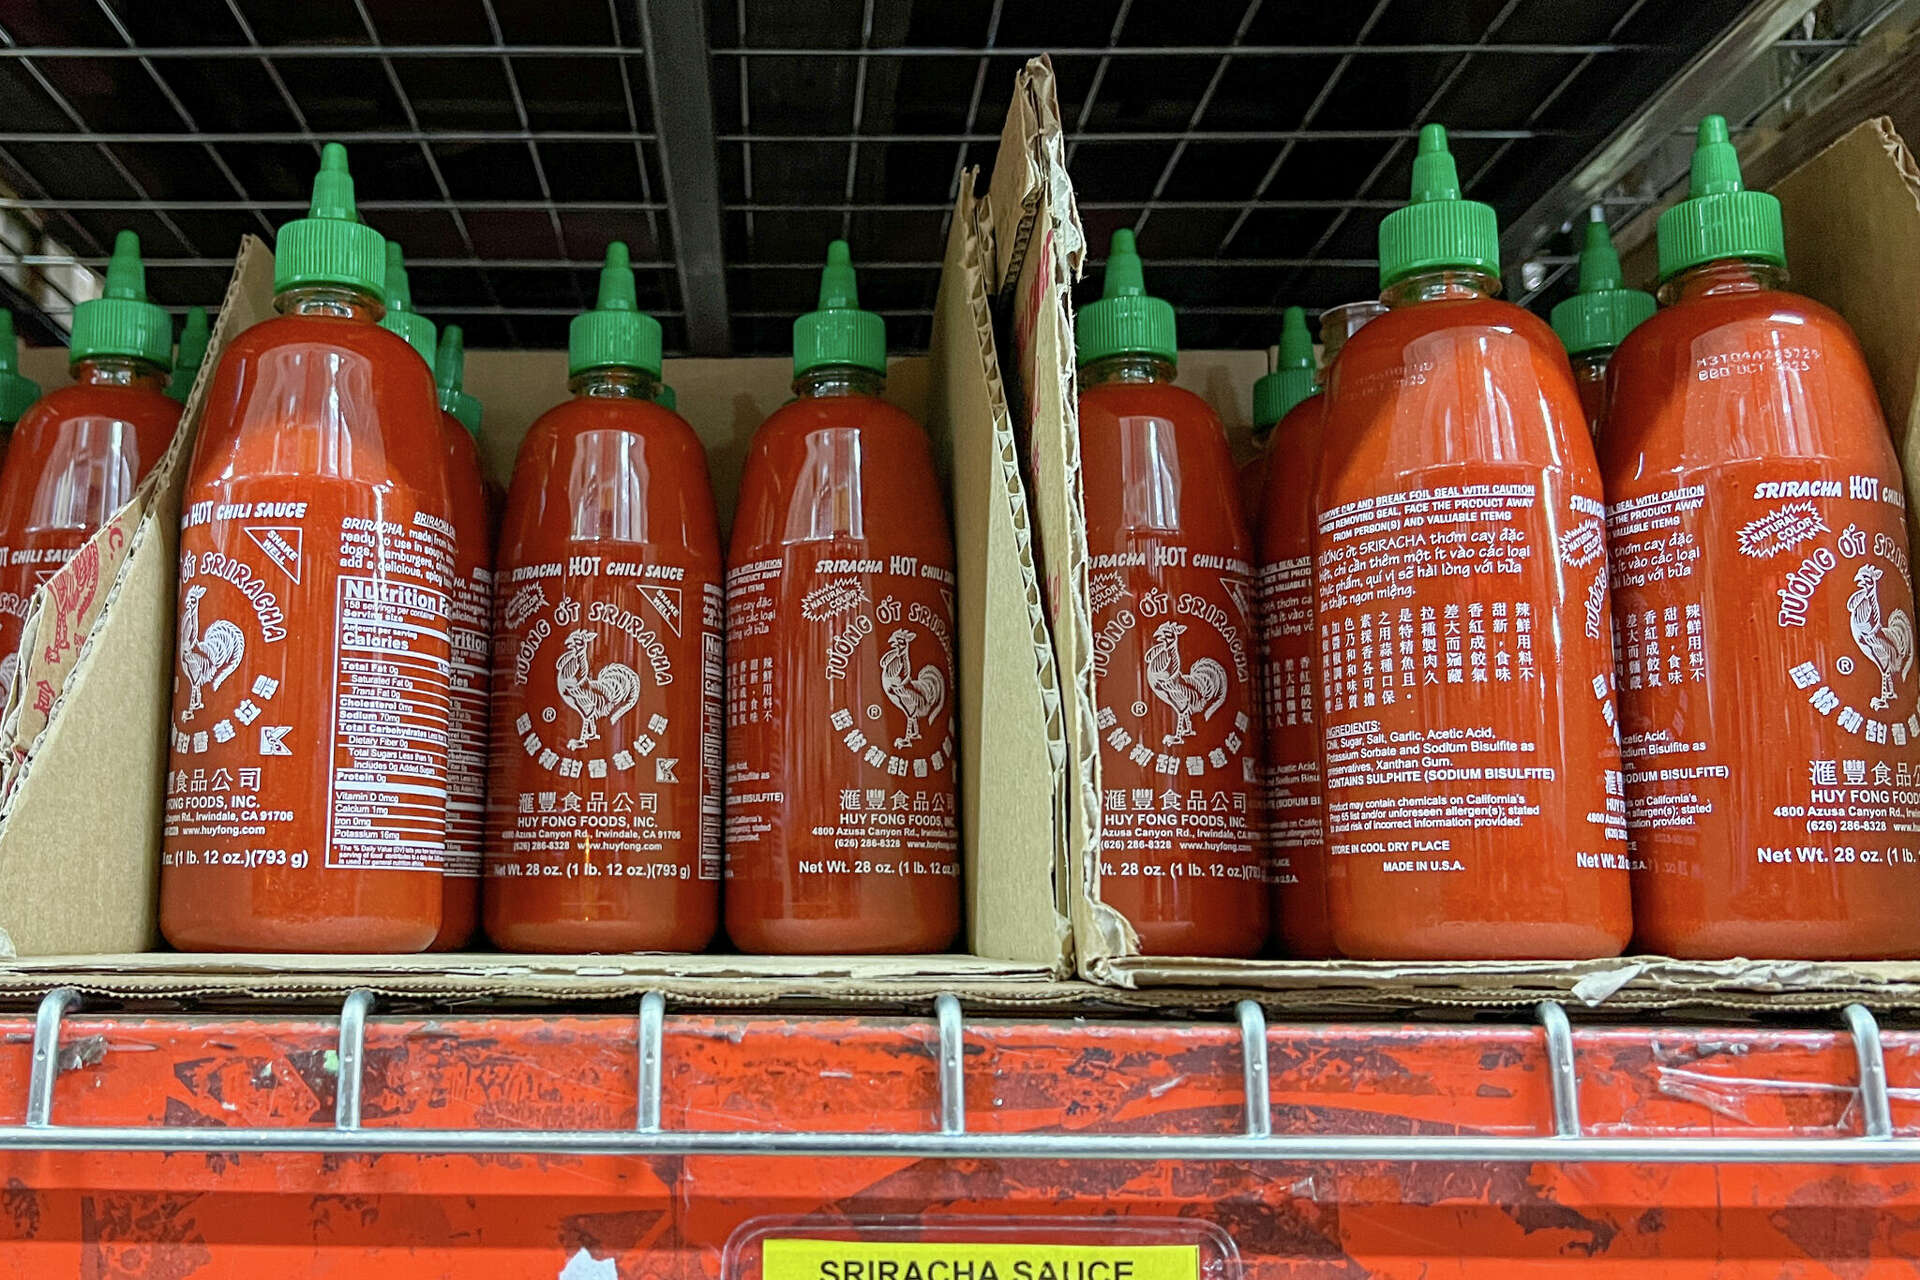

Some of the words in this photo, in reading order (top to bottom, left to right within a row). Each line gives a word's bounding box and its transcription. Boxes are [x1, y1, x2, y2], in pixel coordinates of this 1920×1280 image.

[1462, 486, 1489, 495] WITH
[1493, 485, 1535, 495] CAUTION
[1662, 485, 1705, 501] CAUTION
[1754, 480, 1842, 500] SRIRACHA
[1850, 476, 1878, 502] HOT
[1405, 503, 1429, 514] FACE
[1432, 501, 1453, 511] THE
[1455, 499, 1503, 509] PRODUCT
[1506, 498, 1533, 507] AWAY
[1630, 504, 1671, 520] PRODUCT
[1675, 499, 1704, 511] AWAY
[191, 501, 213, 527] HOT
[217, 504, 252, 520] CHILI
[254, 503, 307, 518] SAUCE
[1404, 516, 1424, 528] AND
[1427, 513, 1477, 524] VALUABLE
[1480, 511, 1512, 521] ITEMS
[1750, 514, 1799, 543] NATURAL
[1777, 517, 1813, 541] COLOR
[267, 529, 298, 561] SHAKE
[341, 532, 375, 547] ready
[394, 539, 411, 549] use
[1360, 534, 1426, 555] SRIRACHA
[1471, 532, 1495, 544] cay
[12, 550, 42, 564] CHILI
[263, 539, 286, 566] WELL
[1154, 547, 1187, 567] HOT
[1193, 555, 1224, 569] CHILI
[340, 558, 362, 568] add
[569, 557, 601, 577] HOT
[606, 562, 642, 577] CHILI
[646, 565, 684, 581] SAUCE
[815, 560, 883, 574] SRIRACHA
[890, 555, 917, 577] HOT
[1442, 562, 1470, 577] lòng
[200, 551, 287, 643] SRIRACHA
[346, 580, 435, 611] Nutrition
[653, 598, 670, 621] WELL
[655, 589, 680, 617] SHAKE
[343, 632, 409, 650] Calories
[588, 602, 672, 686] SRIRACHA
[341, 661, 368, 671] Total
[340, 698, 397, 711] Cholesterol
[340, 711, 378, 721] Sodium
[1390, 731, 1424, 742] Garlic,
[1427, 728, 1463, 739] Acetic
[1361, 748, 1396, 758] Sorbate
[1400, 744, 1419, 755] and
[1423, 743, 1467, 753] Sodium
[1471, 741, 1517, 752] Bisulfite
[1520, 742, 1534, 751] as
[1376, 760, 1418, 770] Xanthan
[1422, 757, 1453, 766] Gum.
[336, 772, 374, 782] Protein
[1367, 771, 1421, 784] SULPHITE
[1424, 769, 1481, 783] (SODIUM
[1485, 768, 1555, 781] BISULFITE)
[1661, 766, 1729, 780] BISULFITE)
[186, 796, 227, 809] FOODS,
[232, 796, 260, 808] INC.
[336, 792, 368, 801] Vitamin
[1365, 798, 1395, 808] contain
[1398, 796, 1447, 806] chemicals
[1450, 796, 1463, 804] on
[1811, 790, 1845, 803] HUY
[1850, 790, 1890, 803] FONG
[1892, 792, 1920, 805] FOOD
[241, 811, 258, 821] CA
[1389, 808, 1442, 818] unforeseen
[1508, 806, 1539, 815] stated
[1681, 804, 1712, 814] stated
[1774, 807, 1804, 817] 4800
[1807, 807, 1846, 817] Azusa
[1849, 807, 1886, 820] Canyon
[518, 818, 537, 827] HUY
[542, 817, 576, 827] FONG
[580, 817, 630, 828] FOODS,
[634, 818, 657, 828] INC.
[840, 814, 866, 825] HUY
[871, 814, 905, 825] FONG
[1105, 815, 1133, 825] HUY
[1137, 815, 1177, 825] FONG
[1181, 815, 1226, 827] FOODS,
[1364, 821, 1372, 830] of
[1374, 820, 1412, 830] incorrect
[1414, 817, 1471, 828] information
[1474, 817, 1523, 829] provided.
[1807, 820, 1837, 833] (626)
[1840, 820, 1886, 832] 286-8328
[183, 826, 265, 836] www.huyfong.com
[334, 830, 378, 838] Potassium
[539, 829, 571, 839] Canyon
[642, 830, 655, 838] CA
[812, 827, 834, 836] 4800
[836, 828, 864, 836] Azusa
[868, 827, 901, 838] Canyon
[1101, 828, 1132, 837] Azusa
[1135, 828, 1173, 839] Canyon
[1360, 842, 1385, 853] COOL
[1388, 841, 1408, 852] DRY
[1411, 841, 1450, 851] PLACE
[186, 851, 200, 865] lb.
[204, 851, 219, 864] 12
[1577, 852, 1599, 868] Net
[1758, 848, 1790, 862] Net
[1796, 848, 1828, 862] Wt.
[1835, 848, 1856, 862] 28
[1860, 851, 1882, 862] oz.
[526, 864, 539, 875] 28
[544, 866, 562, 875] oz.
[567, 864, 578, 878] (1
[607, 864, 622, 876] 12
[799, 861, 822, 873] Net
[826, 861, 850, 873] Wt.
[855, 862, 871, 873] 28
[876, 864, 894, 873] oz.
[899, 862, 910, 876] (1
[913, 862, 926, 874] lb.
[1121, 863, 1139, 876] 28
[1143, 866, 1165, 875] oz.
[1170, 864, 1182, 879] (1
[1188, 864, 1204, 876] lb.
[1383, 862, 1413, 872] MADE
[1416, 862, 1427, 871] IN
[1430, 861, 1464, 871] U.S.A.
[820, 1260, 998, 1280] SRIRACHA
[1014, 1260, 1134, 1280] SAUCE
